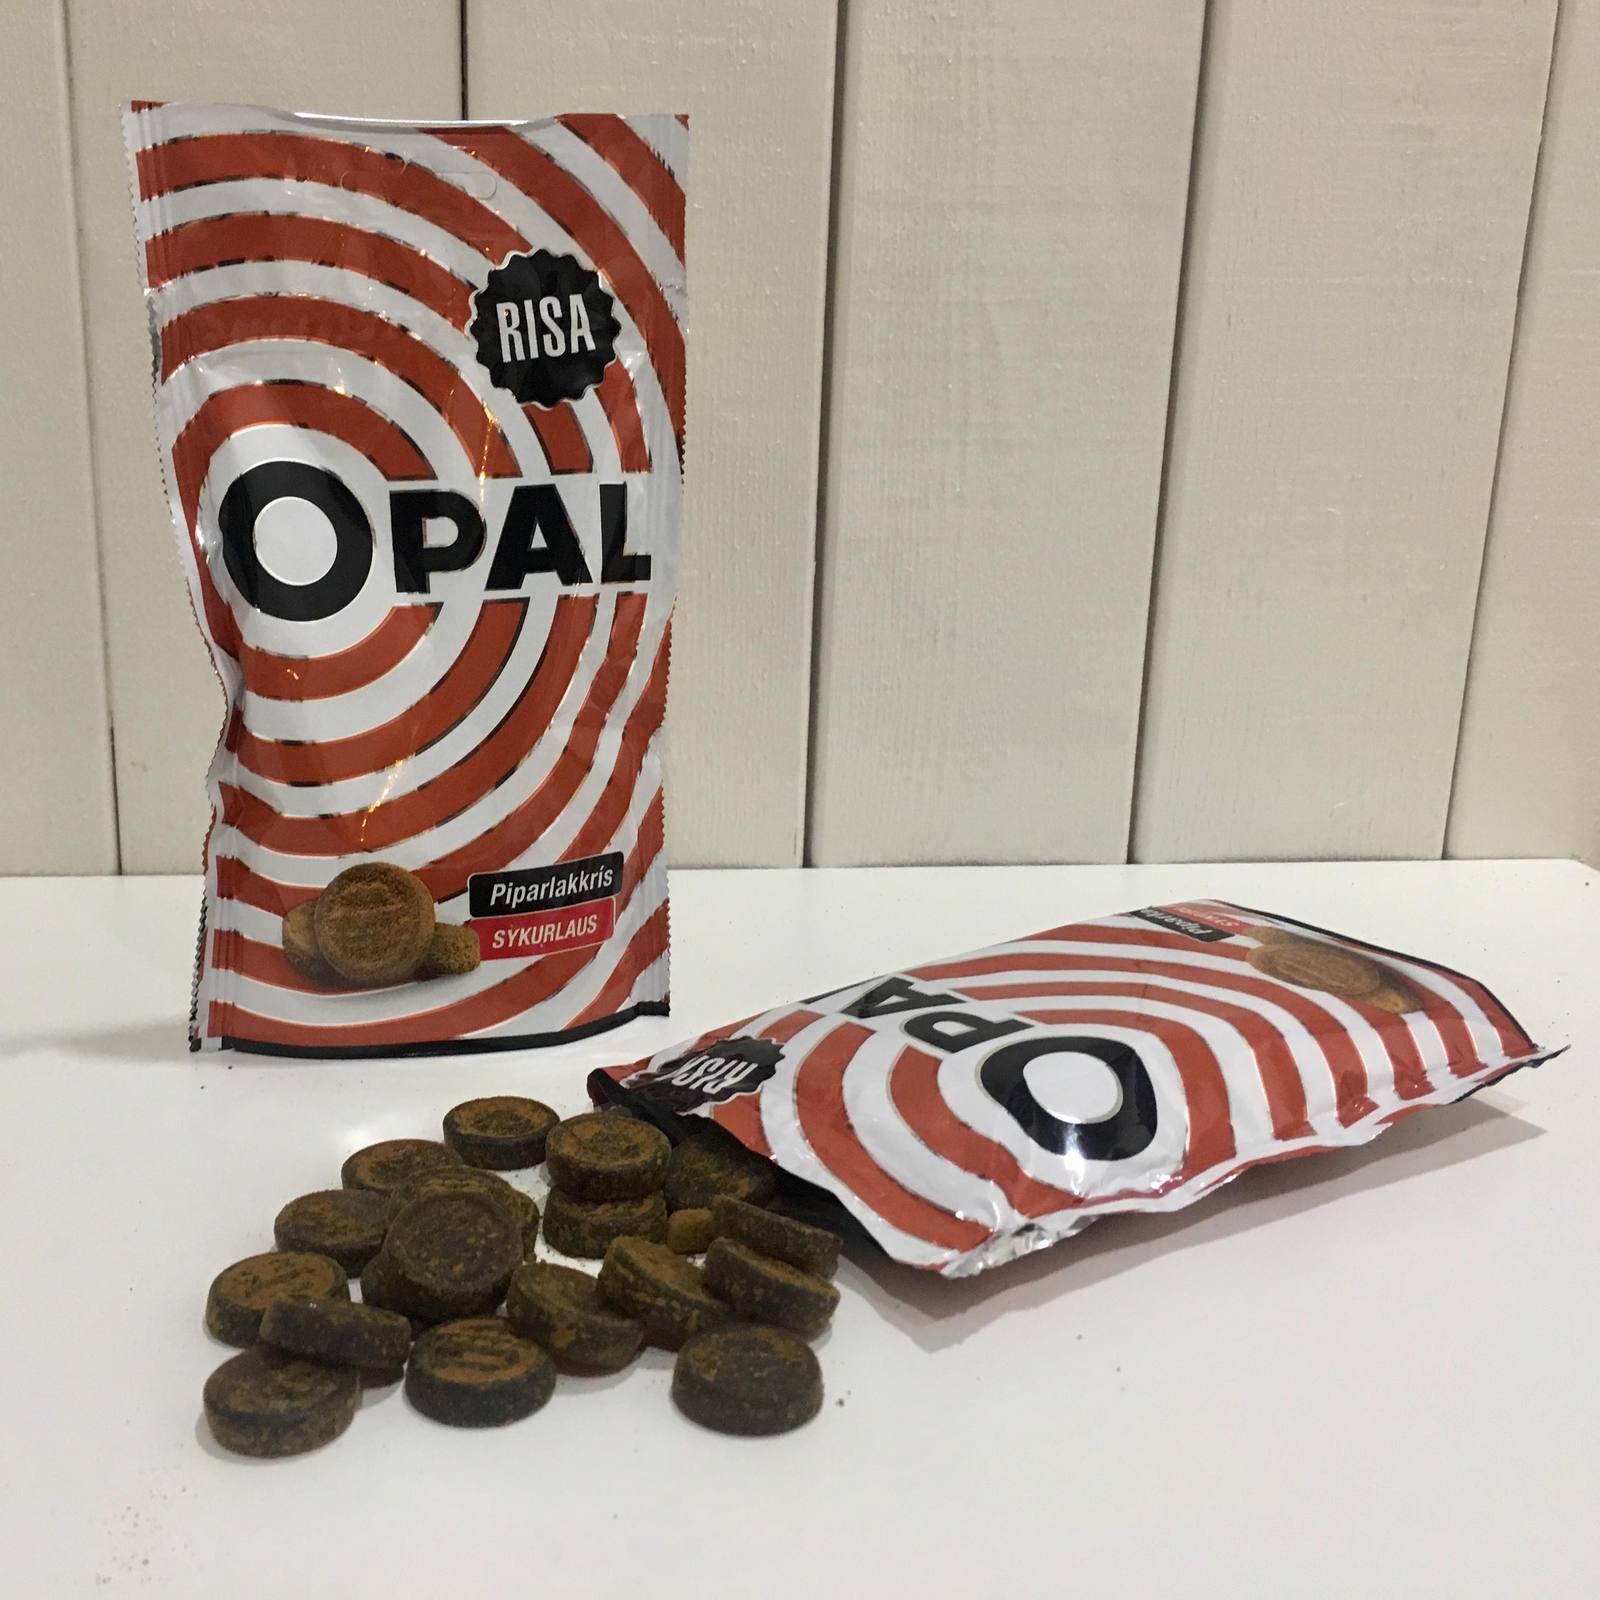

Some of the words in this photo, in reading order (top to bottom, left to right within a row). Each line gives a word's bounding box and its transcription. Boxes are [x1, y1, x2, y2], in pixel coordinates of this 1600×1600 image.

[496, 293, 597, 363] RISA
[218, 458, 652, 622] OPAL
[490, 865, 614, 908] Piparlakkrís
[492, 915, 598, 949] SYKURLAUS
[800, 975, 1158, 1161] OPA
